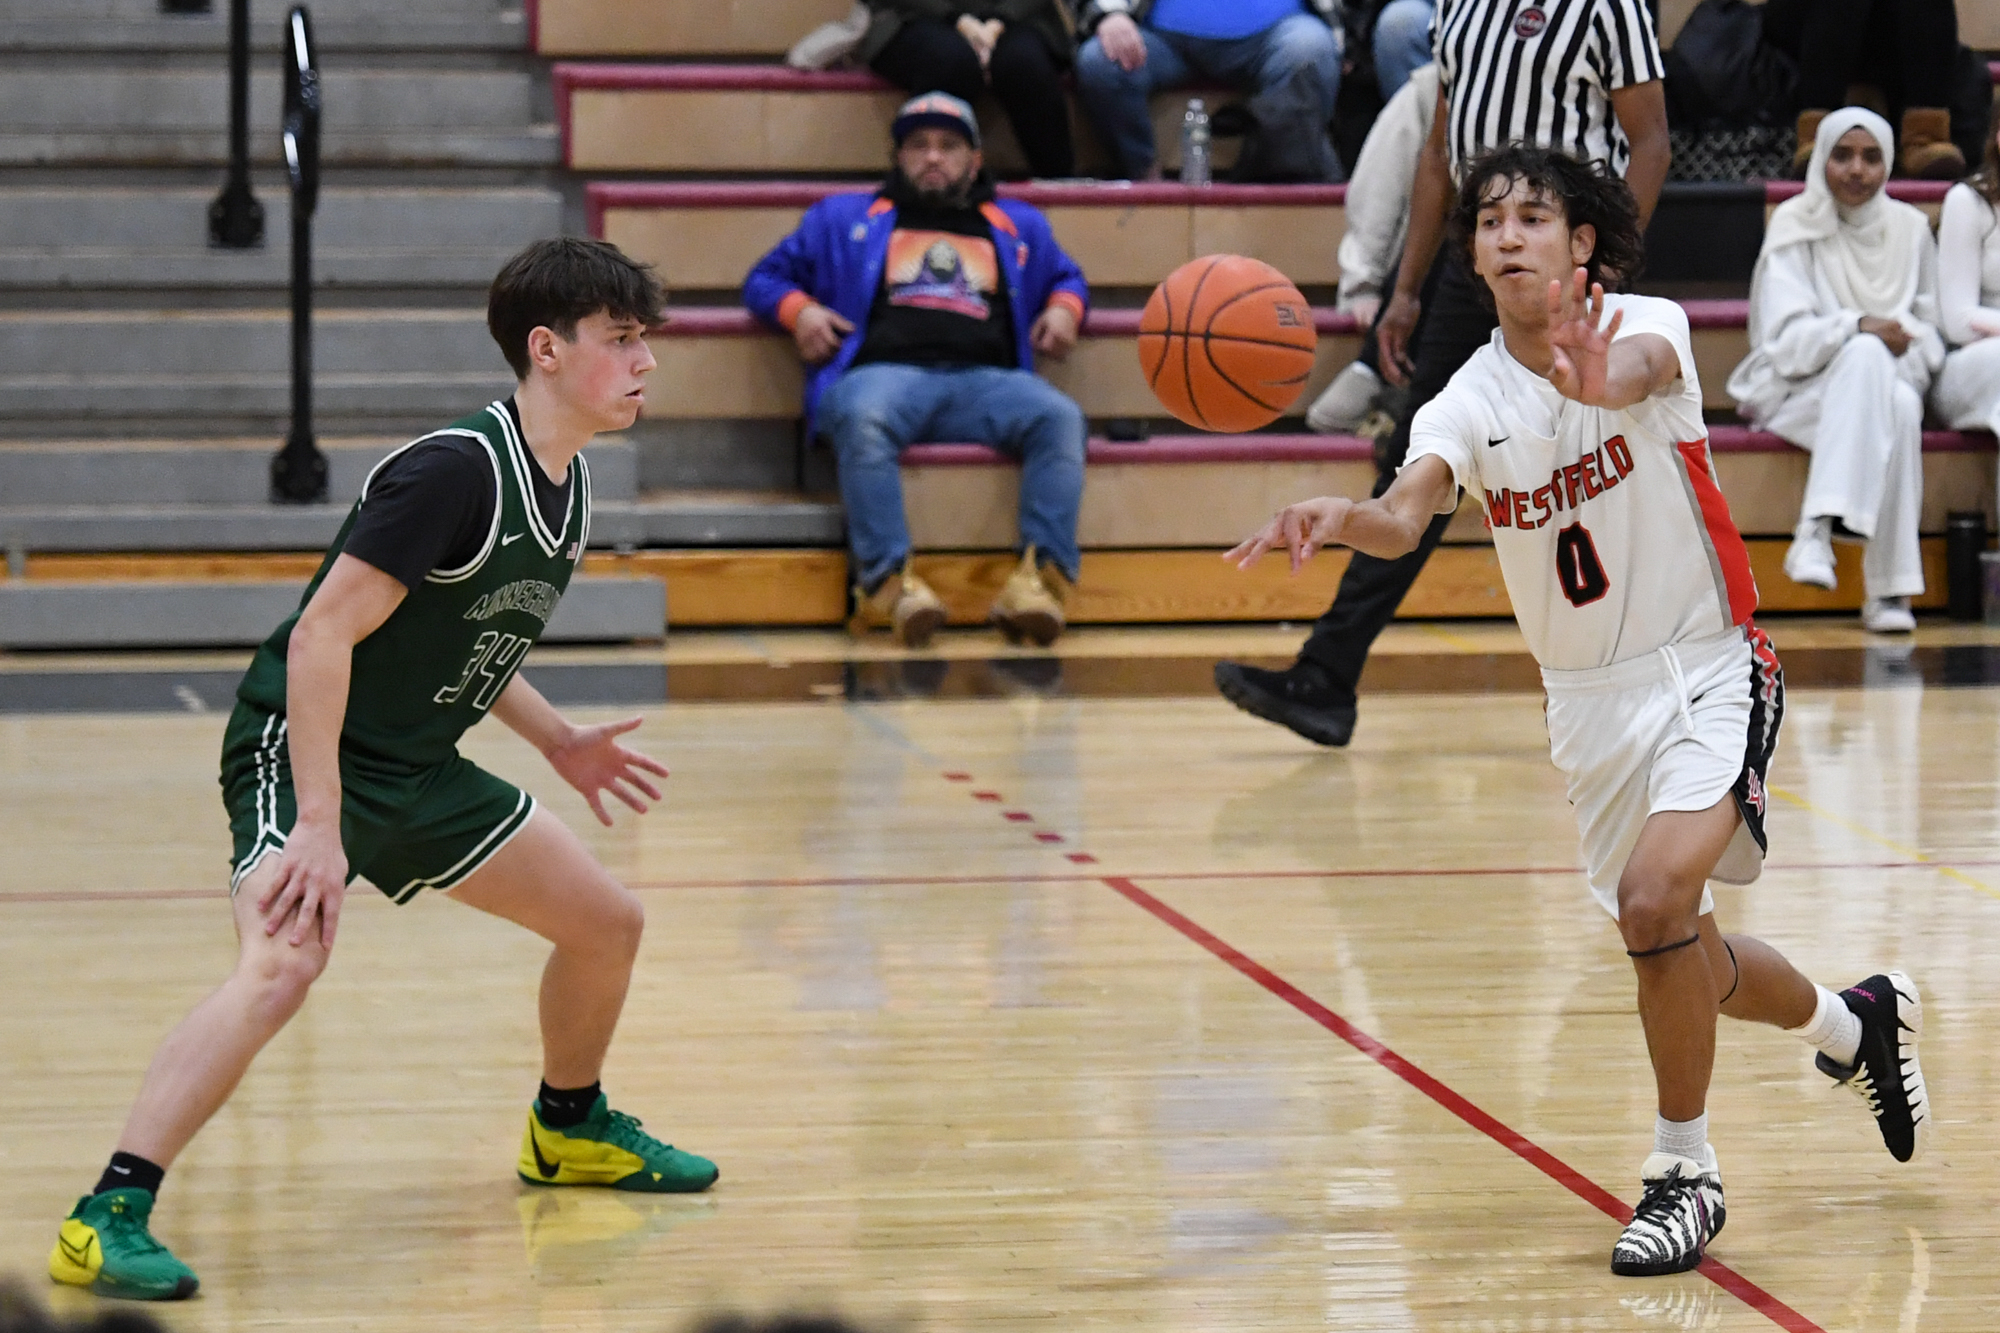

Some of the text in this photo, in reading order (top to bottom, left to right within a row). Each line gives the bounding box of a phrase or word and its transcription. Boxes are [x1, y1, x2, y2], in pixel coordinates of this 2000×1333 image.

[1485, 434, 1635, 530] WESTFELD
[1556, 520, 1611, 608] 0
[433, 630, 532, 710] 34
